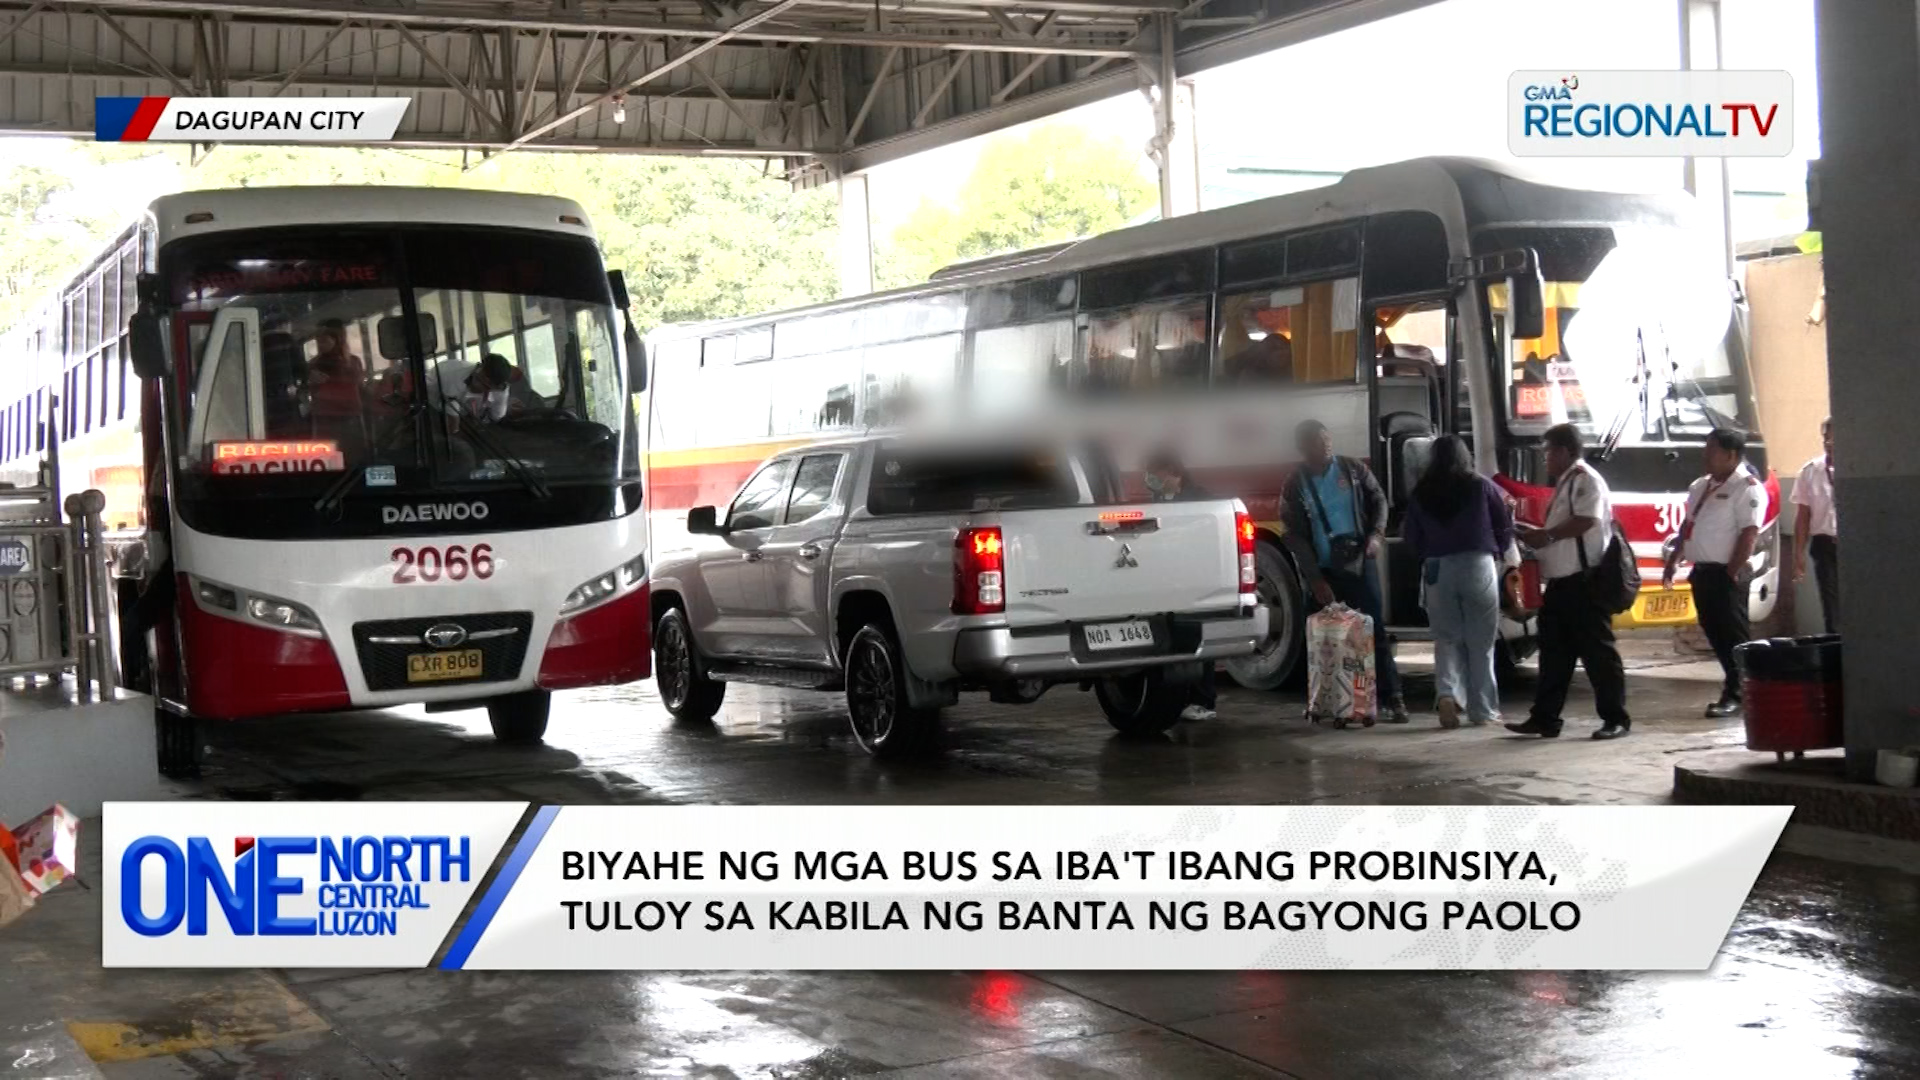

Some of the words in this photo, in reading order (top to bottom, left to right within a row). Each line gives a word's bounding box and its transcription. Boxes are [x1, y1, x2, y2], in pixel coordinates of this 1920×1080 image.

[320, 265, 378, 282] FARE
[382, 501, 490, 524] DAEWOO
[0, 546, 28, 567] AREA
[391, 543, 495, 584] 2066
[410, 655, 442, 673] CXR
